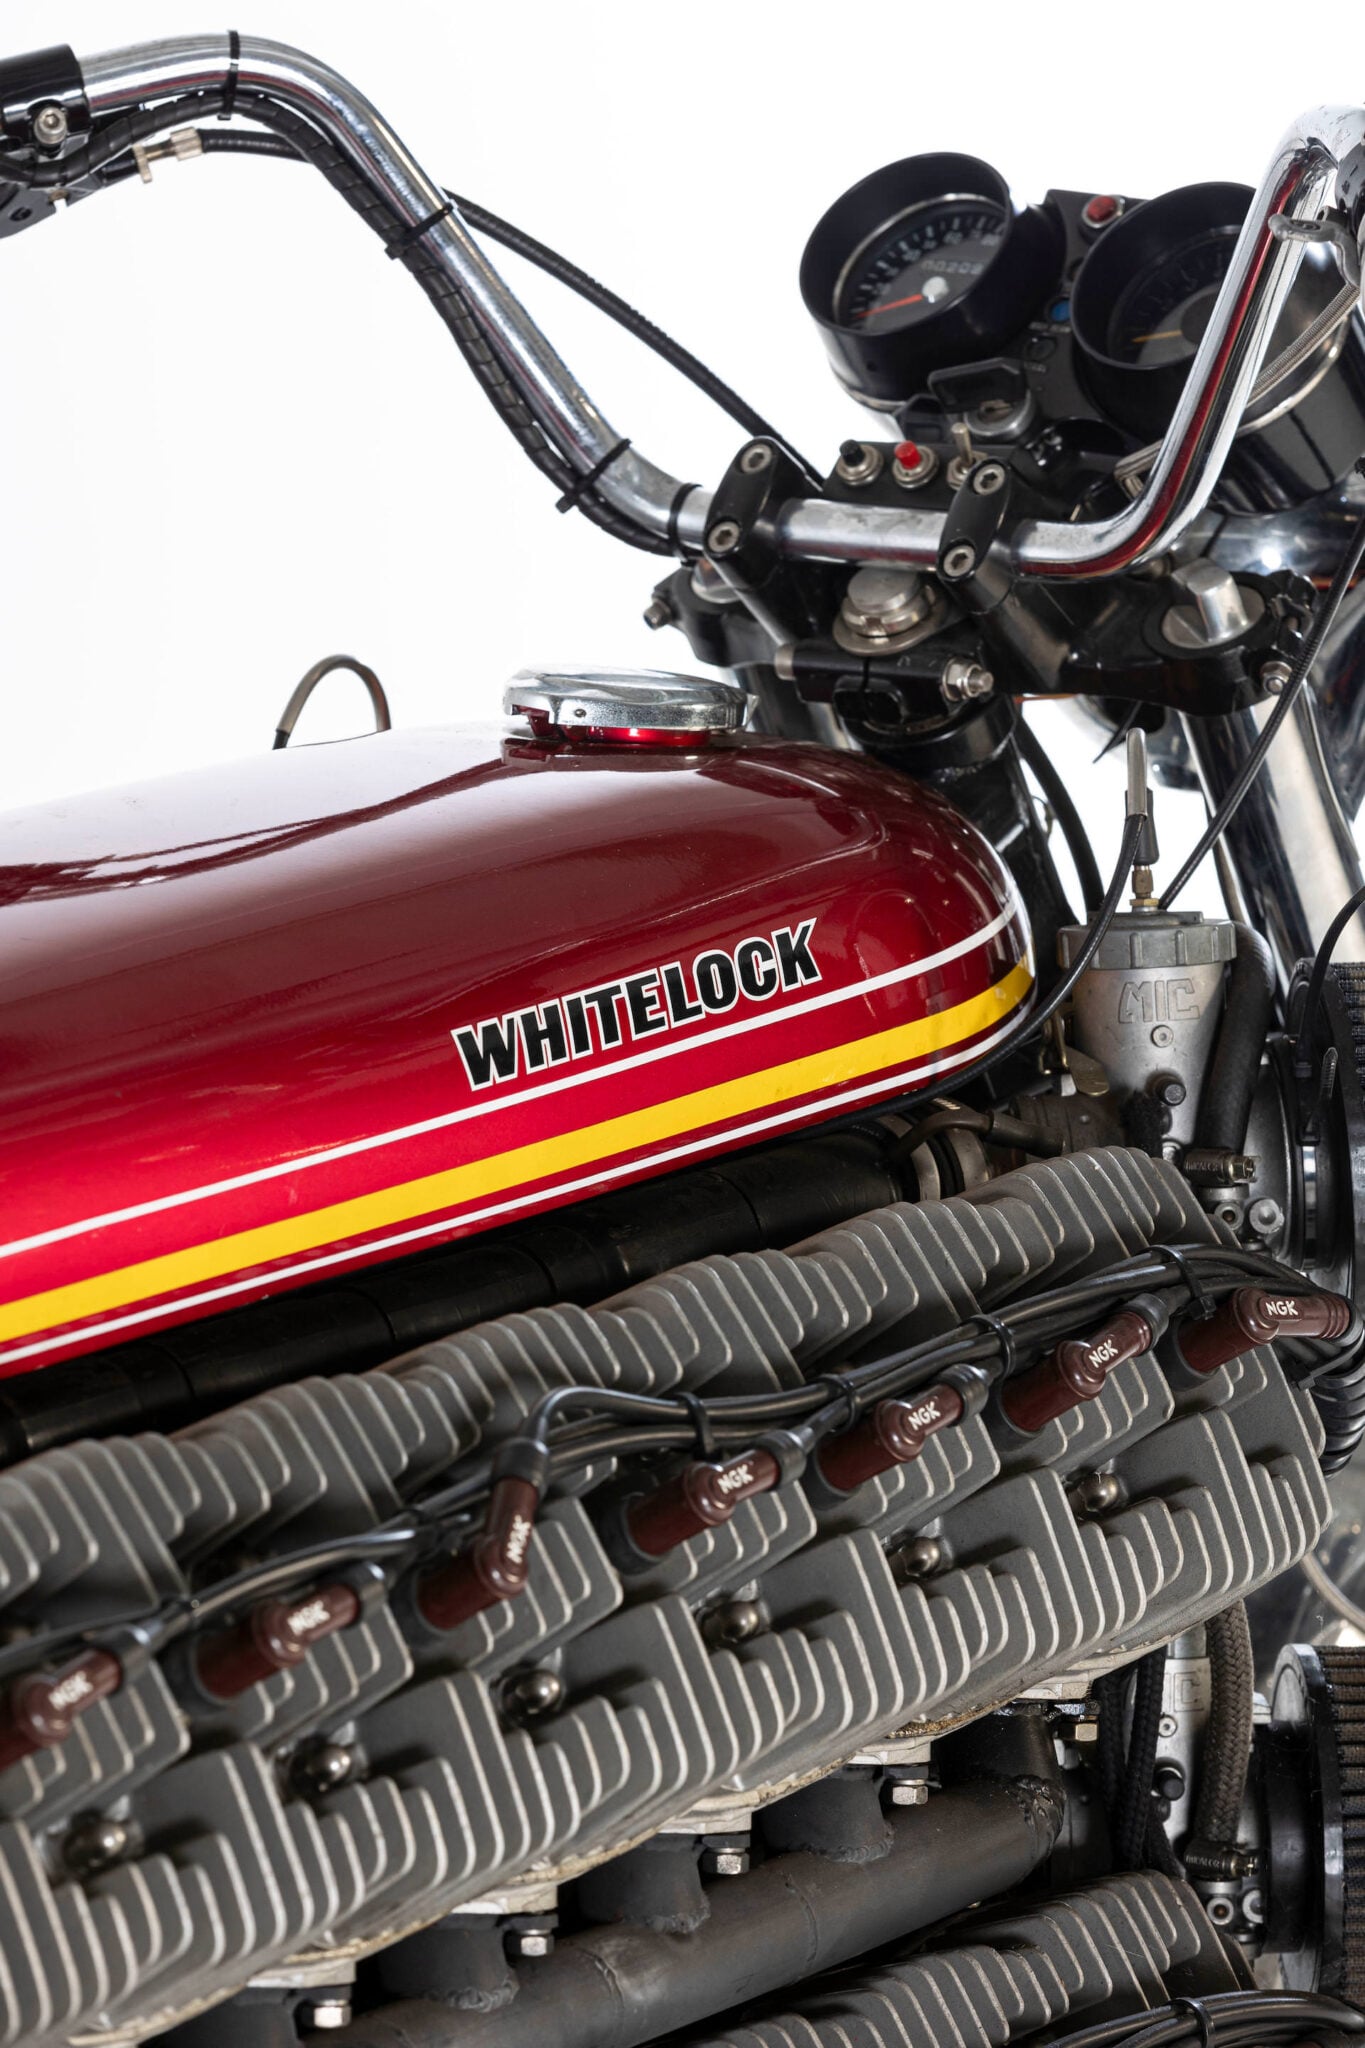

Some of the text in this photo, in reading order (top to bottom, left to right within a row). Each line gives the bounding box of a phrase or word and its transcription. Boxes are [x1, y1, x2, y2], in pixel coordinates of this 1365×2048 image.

[450, 917, 822, 1092] WHITELOCK
[1265, 1300, 1299, 1317] NGK
[1088, 1339, 1119, 1369] NGK
[907, 1400, 942, 1431] NGK
[717, 1464, 754, 1494] NGK
[506, 1514, 532, 1564] NGK
[287, 1600, 331, 1636] NGK
[48, 1670, 94, 1711] NGK
